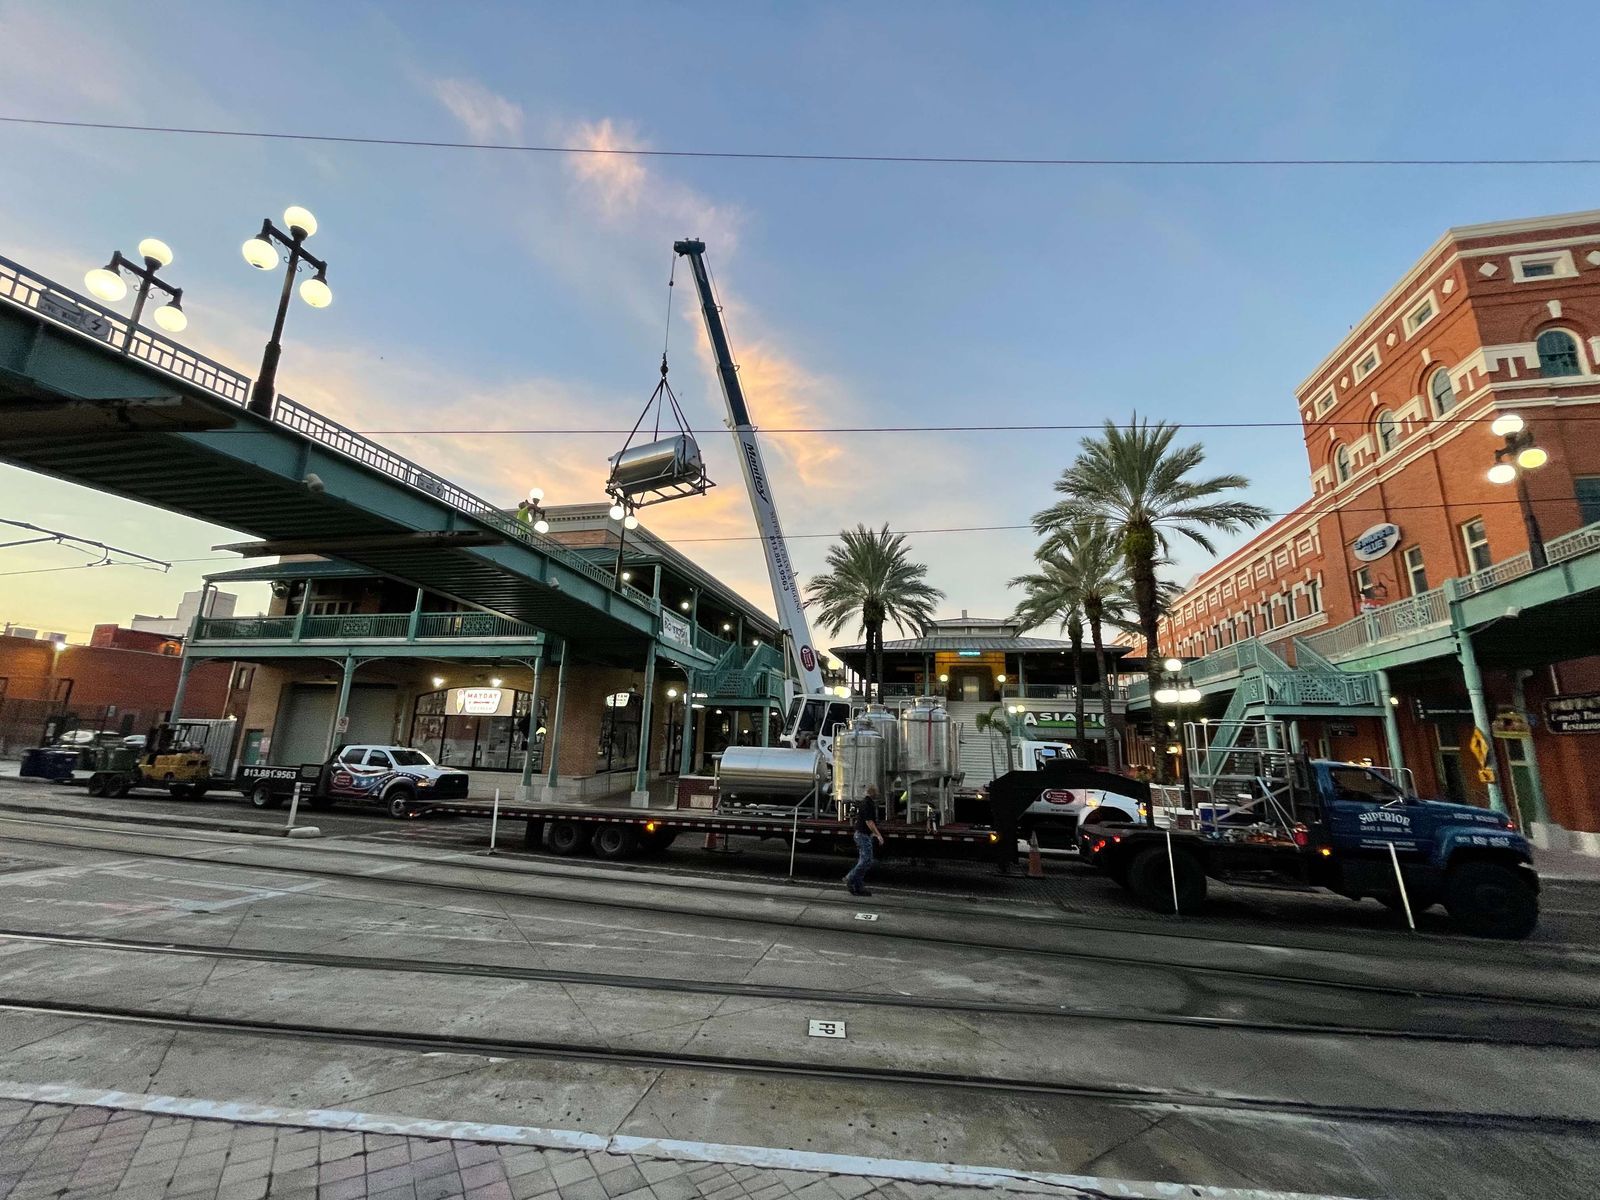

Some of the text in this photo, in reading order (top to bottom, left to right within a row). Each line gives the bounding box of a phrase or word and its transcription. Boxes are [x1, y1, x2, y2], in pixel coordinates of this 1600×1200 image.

[745, 442, 767, 499] Manitex
[1364, 539, 1386, 555] BLUE
[770, 536, 789, 591] 813.881.9563
[244, 769, 296, 779] 813.881.9563
[1358, 811, 1410, 826] SUPERIOR
[819, 1022, 835, 1035] FP
